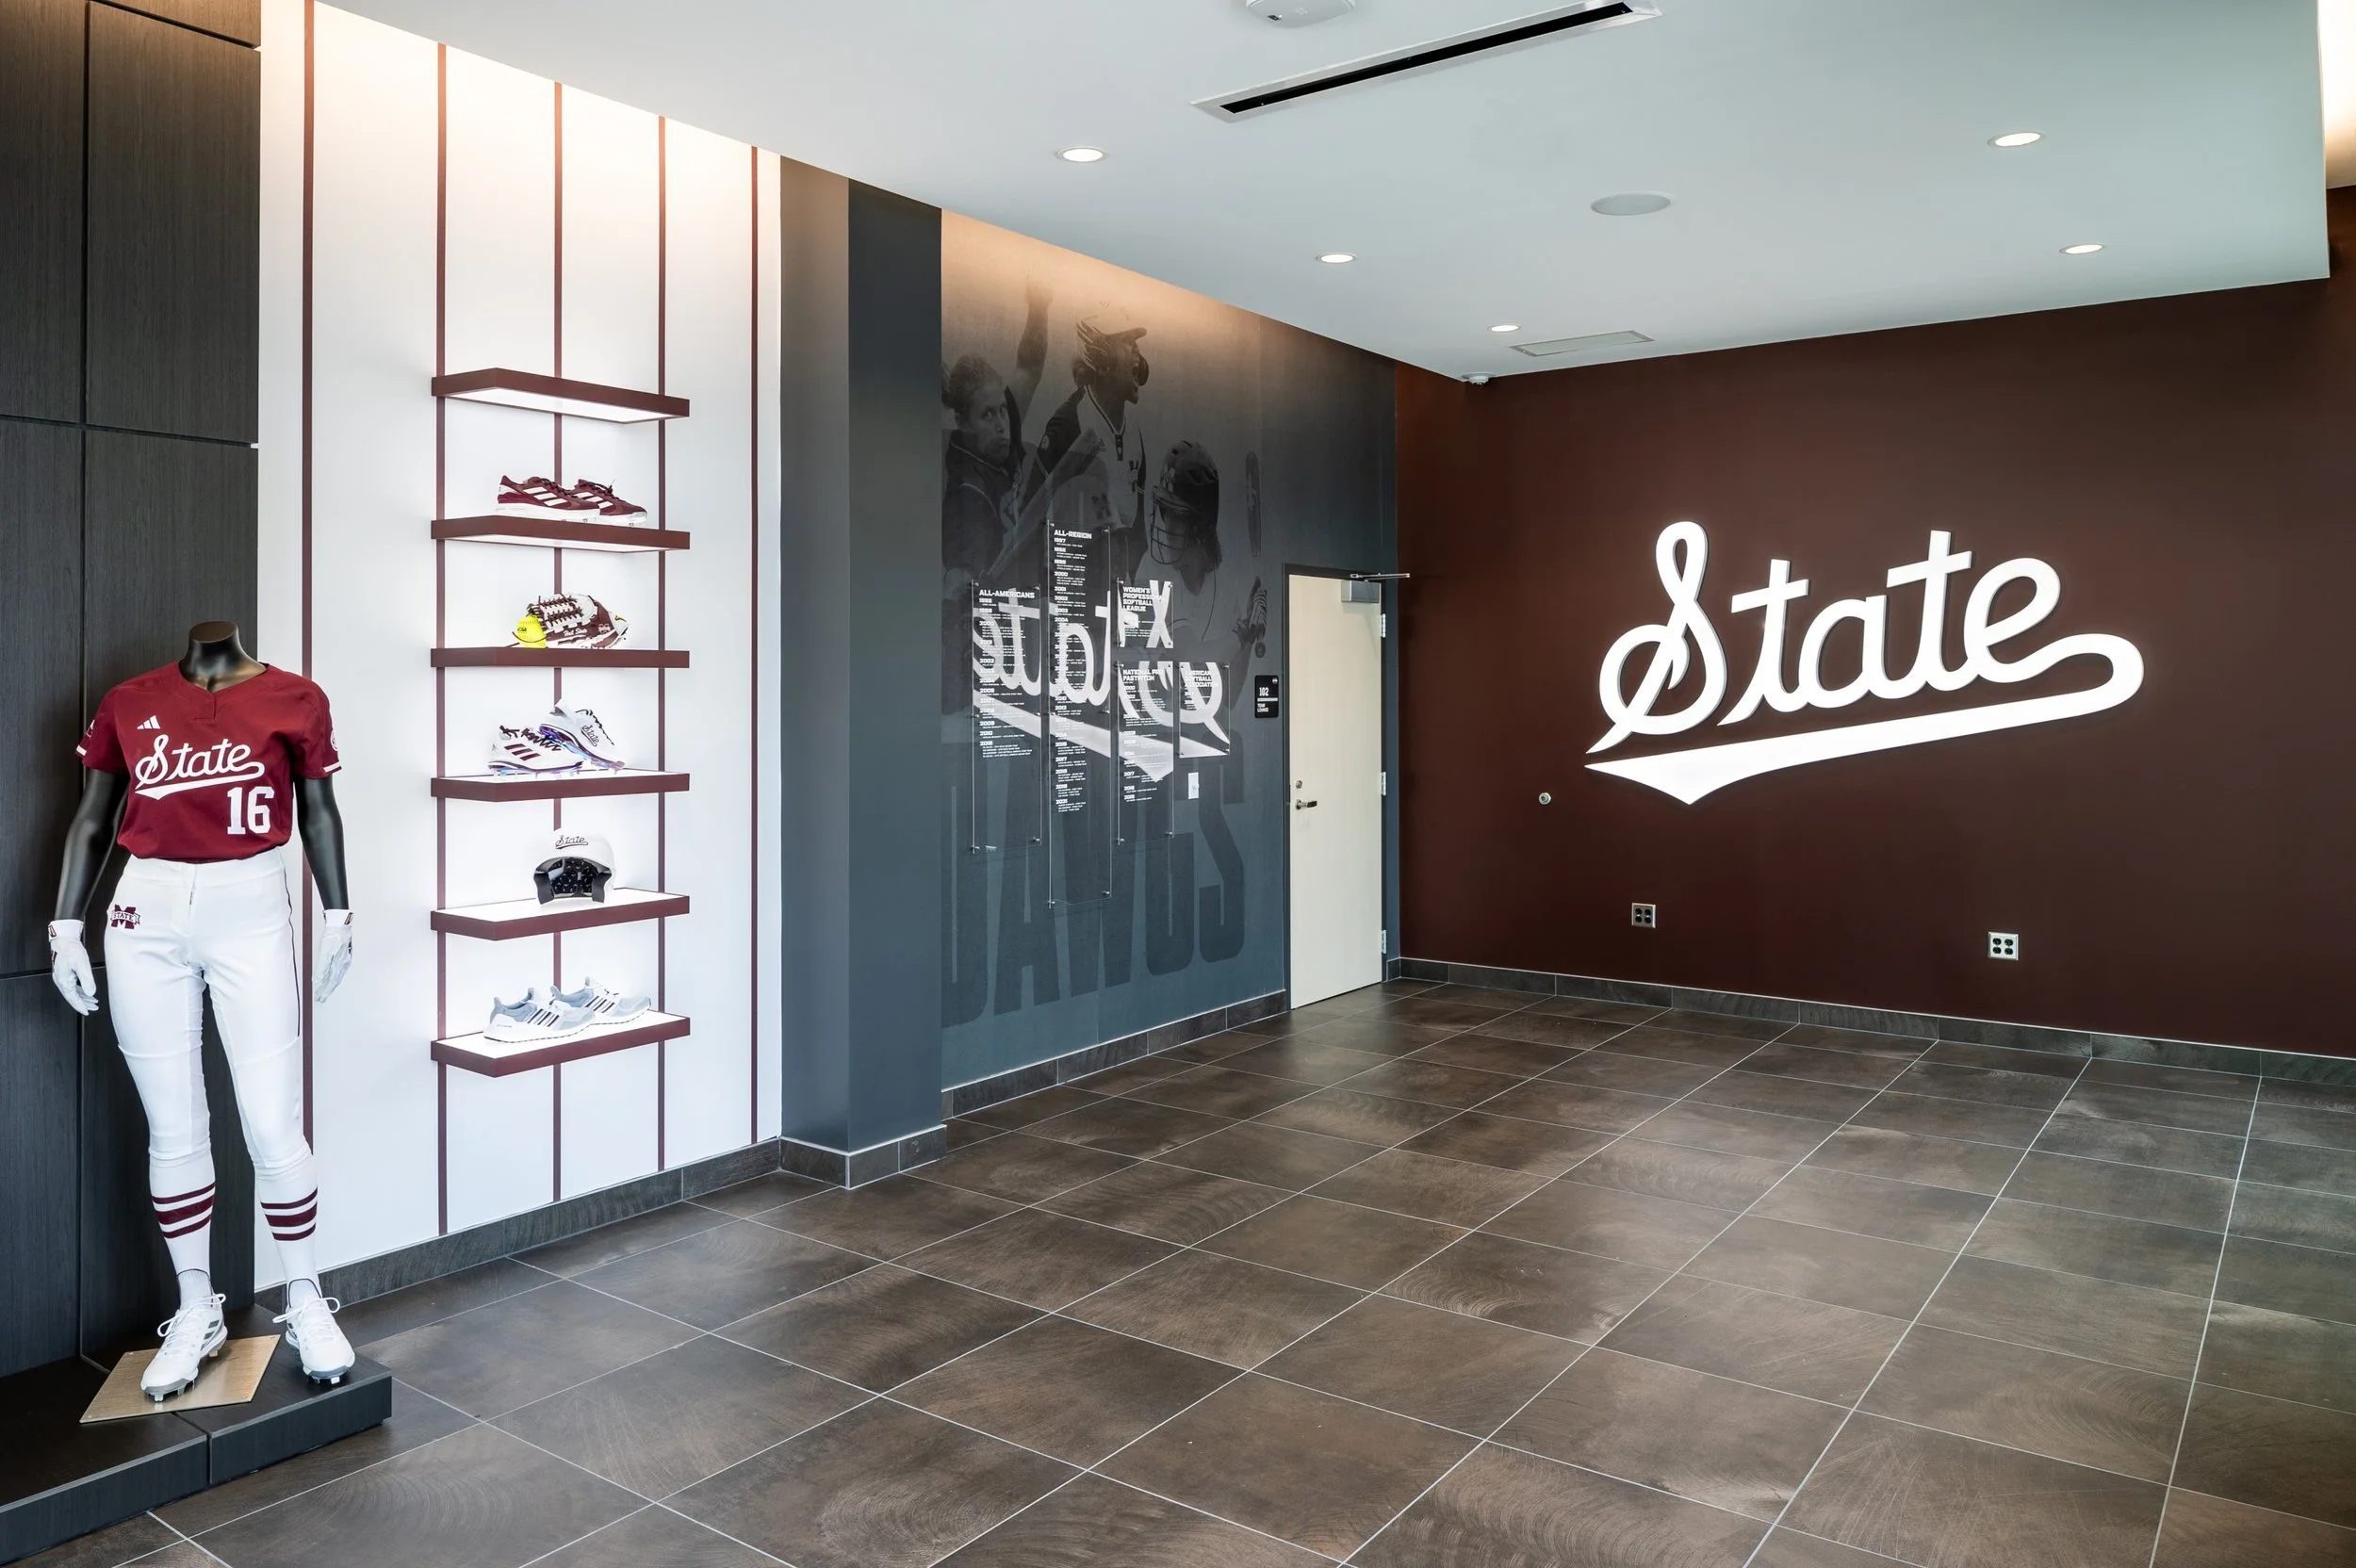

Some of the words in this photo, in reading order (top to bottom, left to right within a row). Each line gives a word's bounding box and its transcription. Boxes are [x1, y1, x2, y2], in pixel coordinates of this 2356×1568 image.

[1054, 530, 1092, 540] ALL-REGION
[979, 589, 1036, 599] ALL-AMERICANS
[1585, 521, 2144, 805] State
[1259, 687, 1269, 696] 102
[581, 725, 600, 747] State
[135, 734, 265, 800] State
[227, 786, 274, 835] 16
[555, 834, 589, 850] State
[112, 911, 135, 922] STATE
